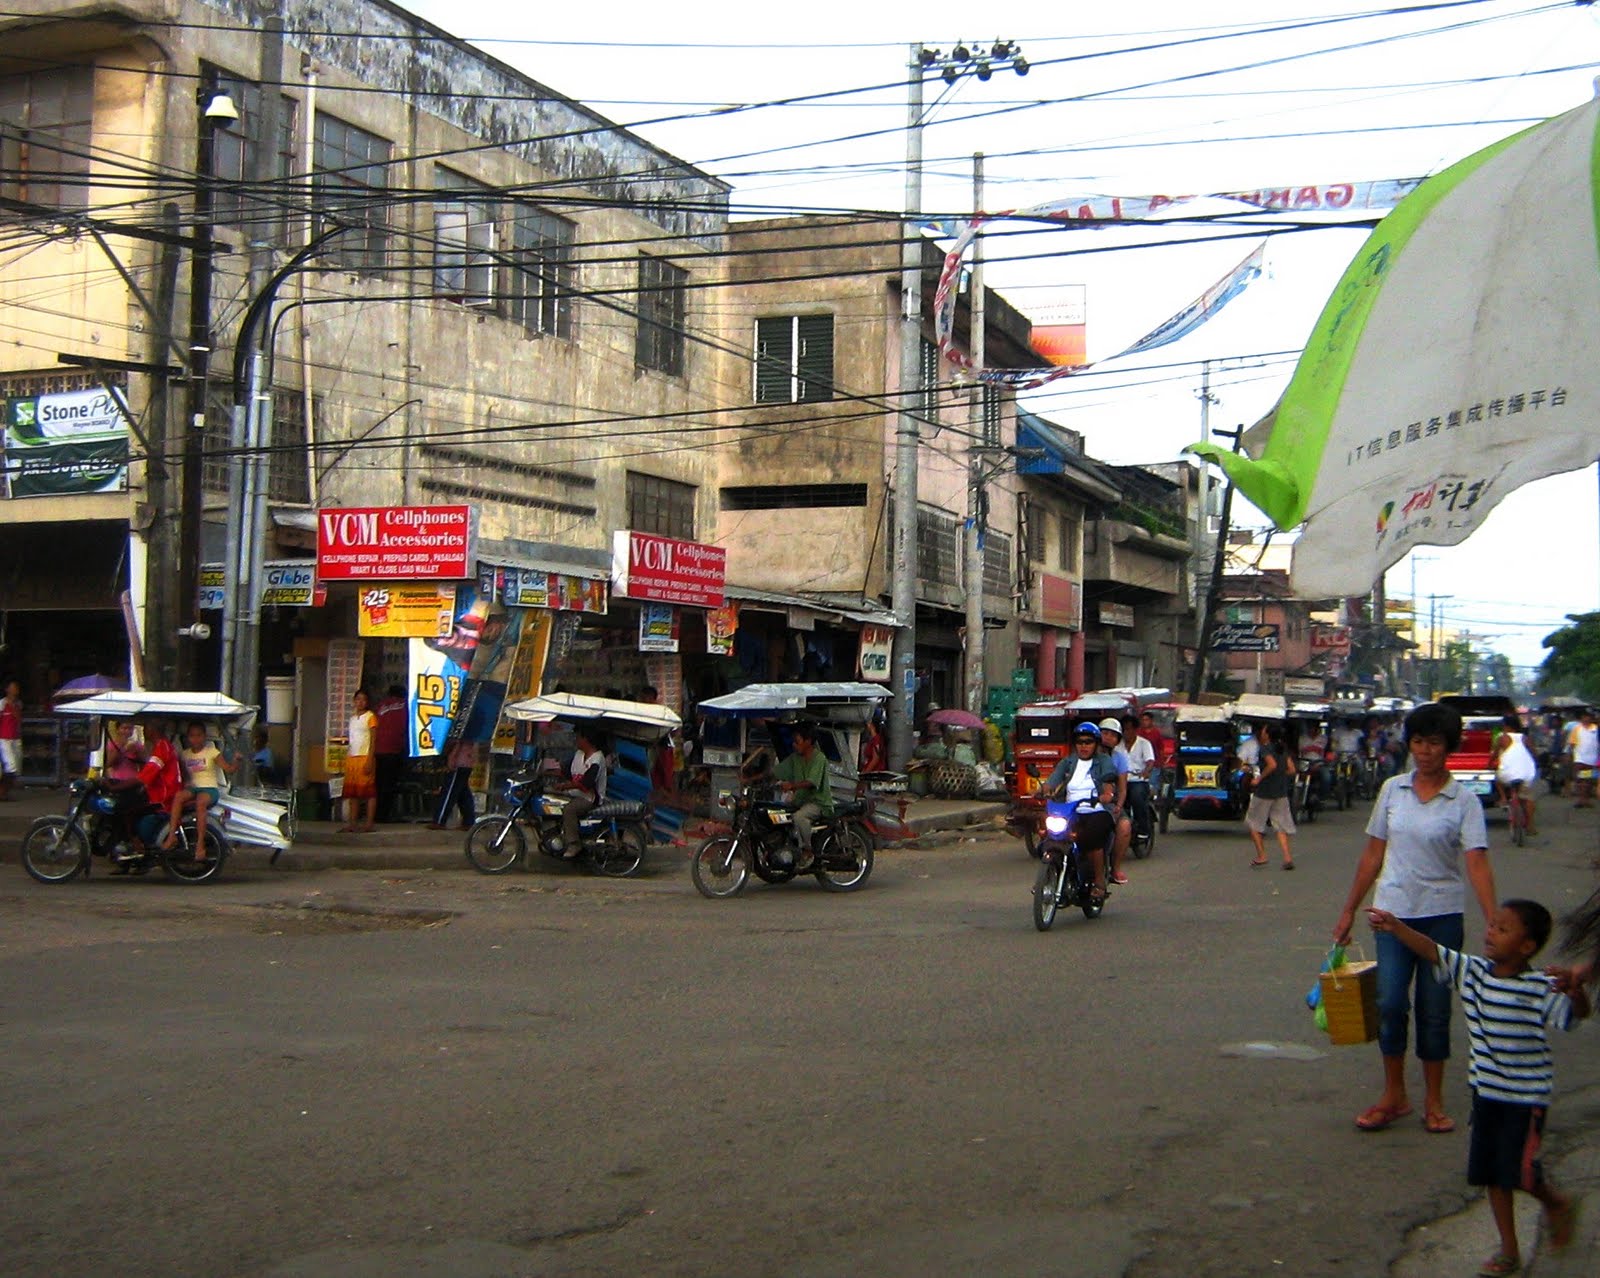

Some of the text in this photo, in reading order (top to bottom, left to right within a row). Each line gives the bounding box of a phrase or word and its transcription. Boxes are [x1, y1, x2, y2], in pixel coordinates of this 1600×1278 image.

[43, 404, 89, 422] Stone
[321, 510, 465, 547] VCM Cellphones
[418, 525, 427, 535] &
[379, 532, 464, 547] Accessories
[631, 536, 726, 572] VCM Cellphones
[267, 569, 311, 585] Globe
